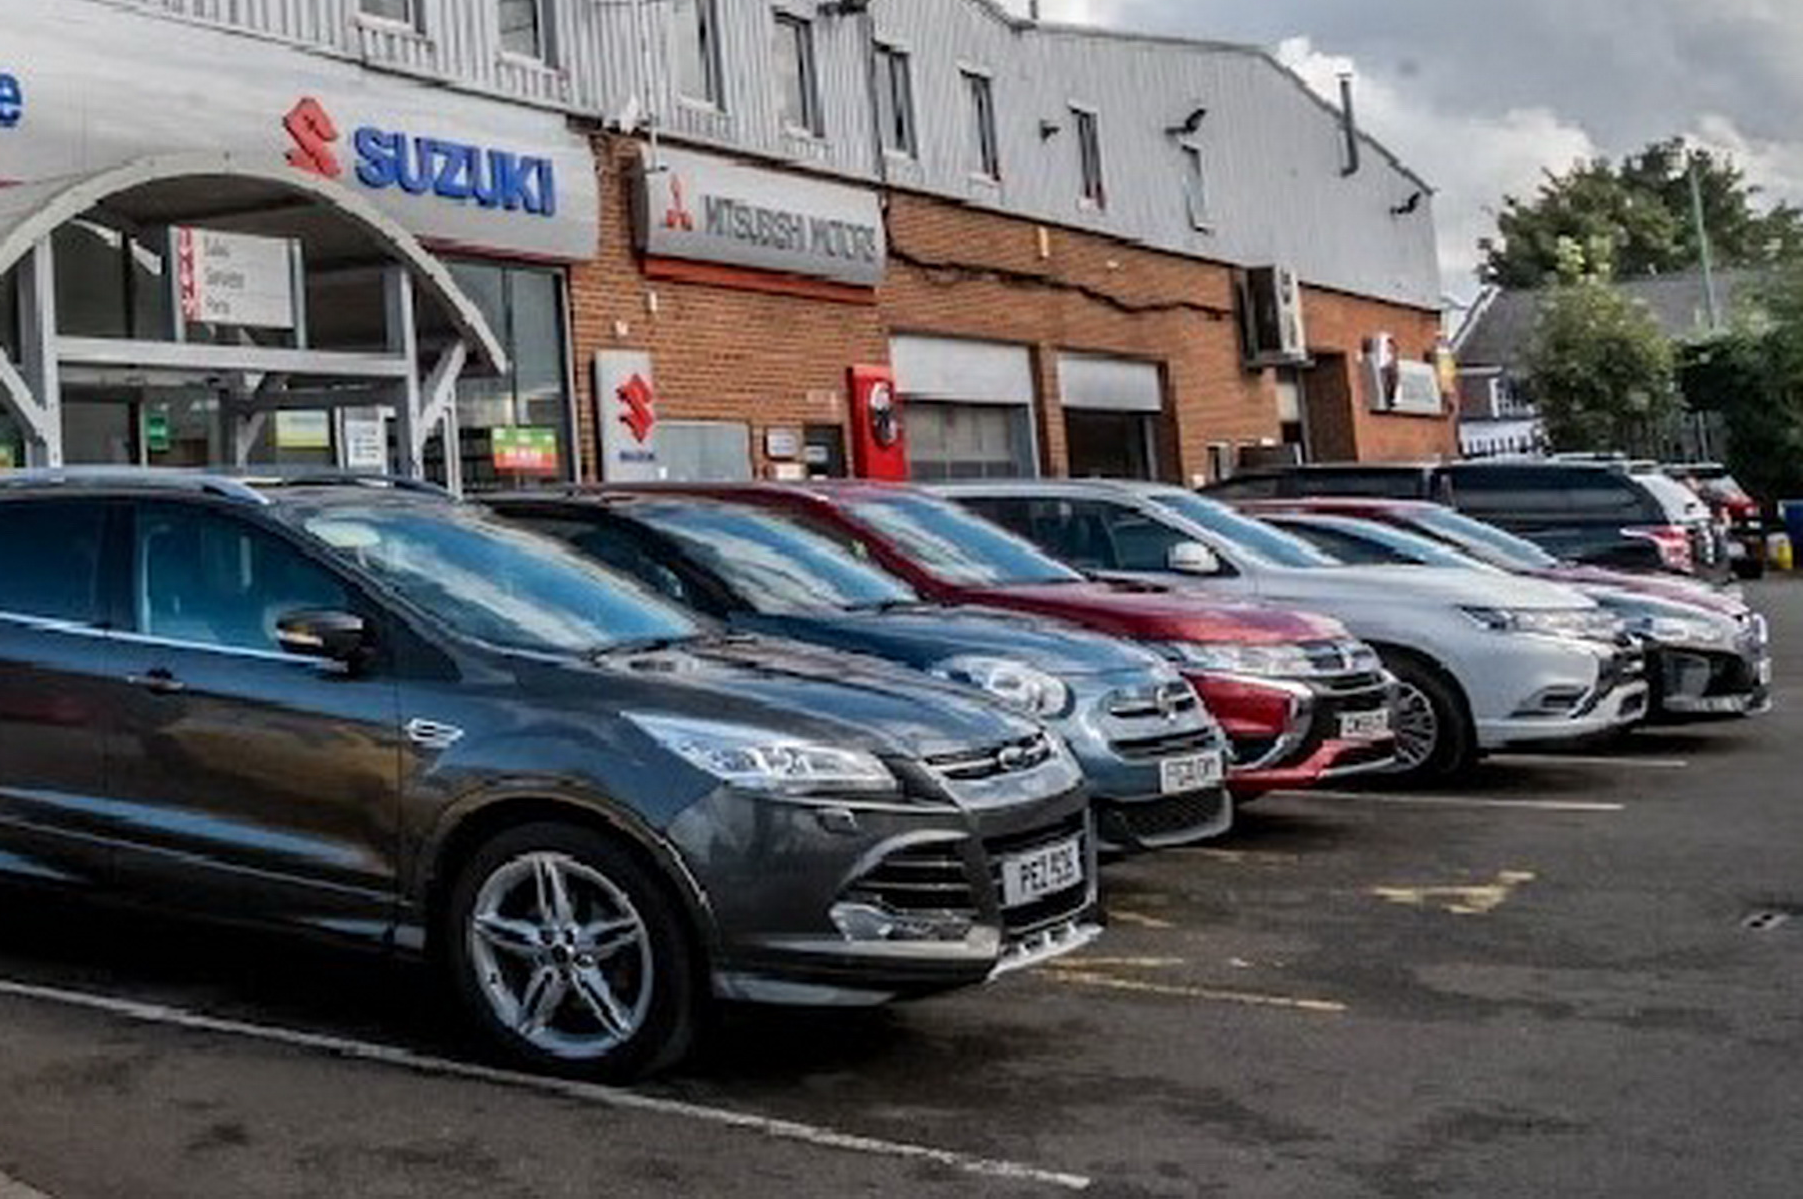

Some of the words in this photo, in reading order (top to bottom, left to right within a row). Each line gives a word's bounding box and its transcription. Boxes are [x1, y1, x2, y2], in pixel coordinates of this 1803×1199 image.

[353, 127, 556, 217] SUZUKI
[703, 195, 806, 251] MITSUBISHI
[810, 215, 876, 262] MOTORS
